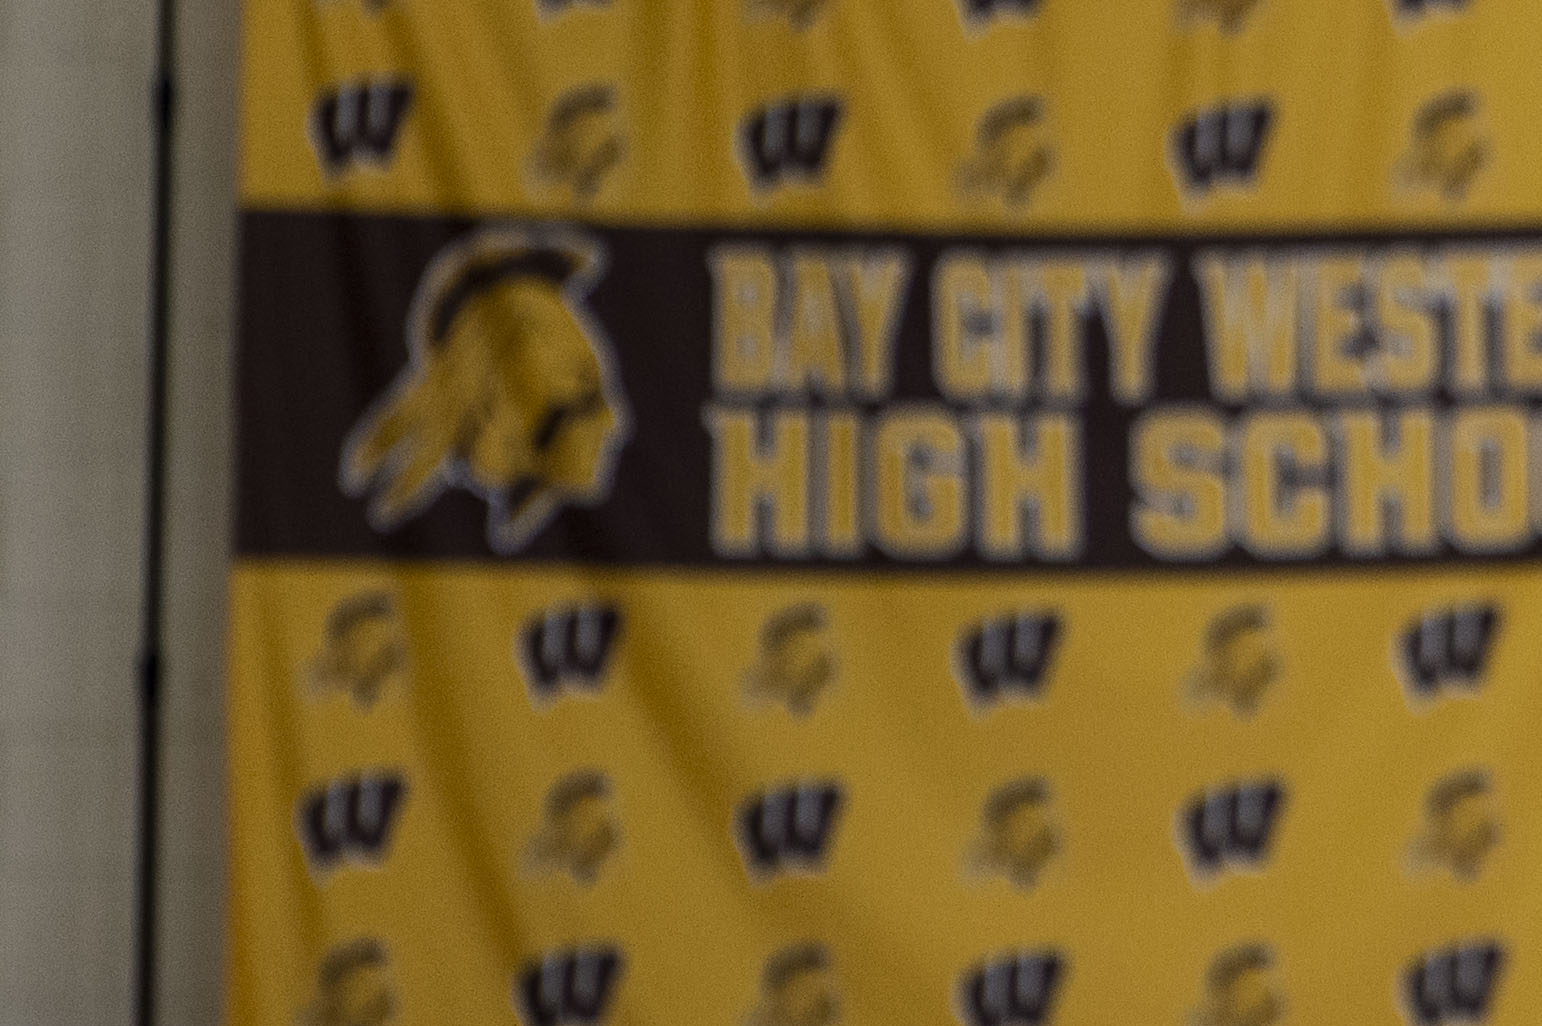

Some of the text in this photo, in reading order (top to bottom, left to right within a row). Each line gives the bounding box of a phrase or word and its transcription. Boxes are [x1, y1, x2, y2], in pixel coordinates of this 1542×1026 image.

[708, 245, 908, 398] BAY
[931, 248, 1171, 402] CITY
[705, 403, 1083, 561] HIGH
